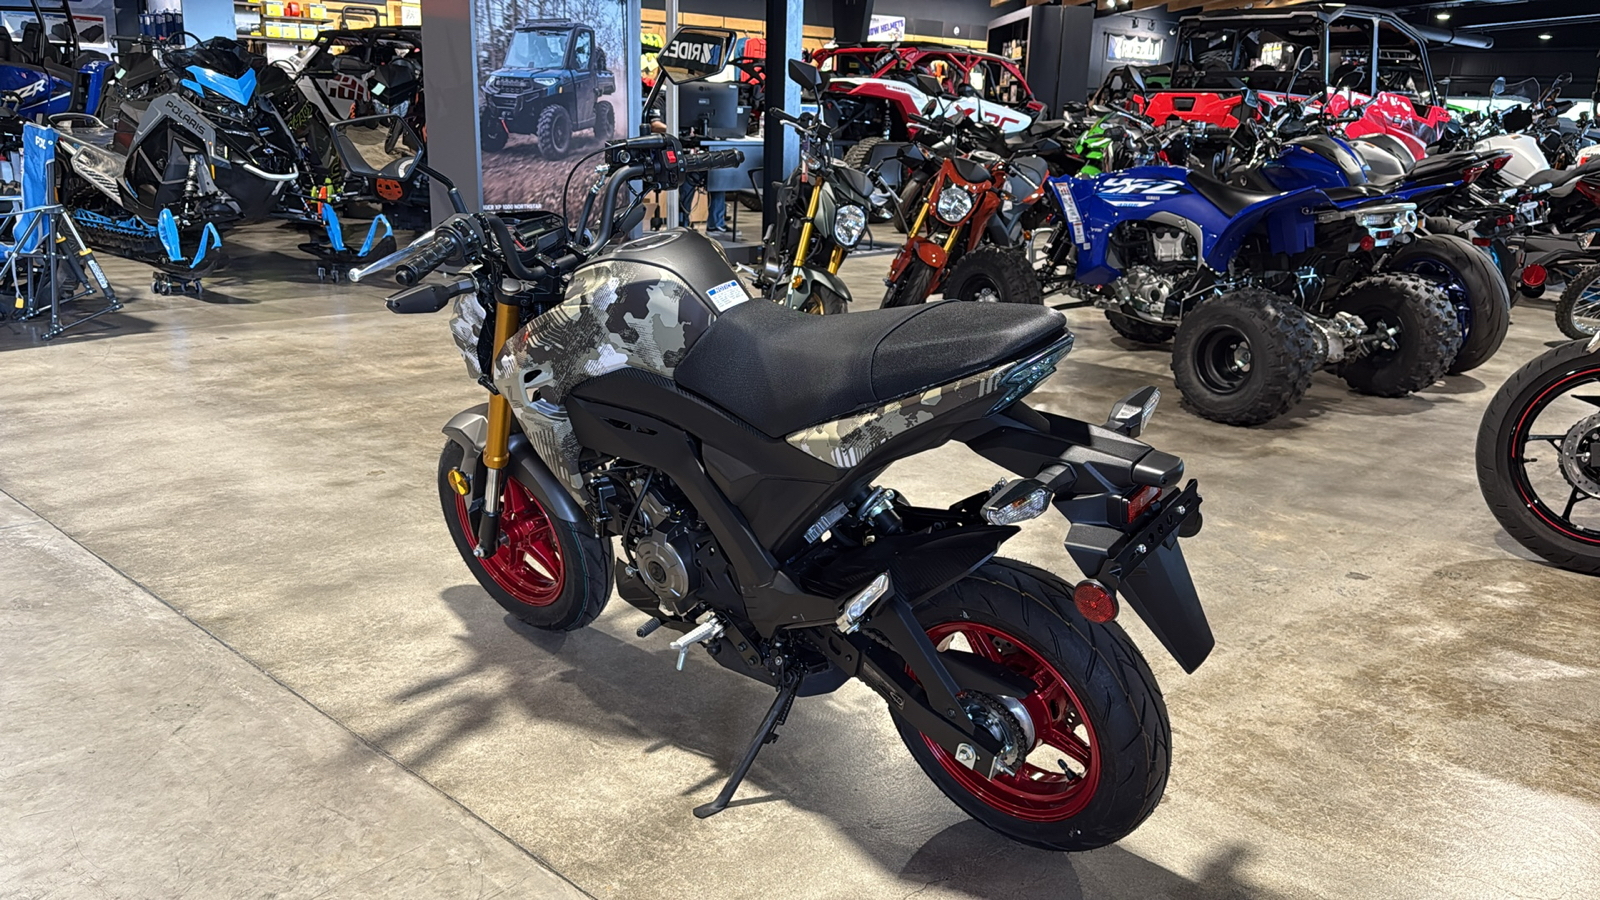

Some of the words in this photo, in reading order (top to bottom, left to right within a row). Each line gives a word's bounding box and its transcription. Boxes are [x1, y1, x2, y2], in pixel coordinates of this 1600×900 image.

[880, 20, 904, 34] HELMETS
[13, 79, 46, 100] ZR
[165, 100, 206, 136] POLARIS
